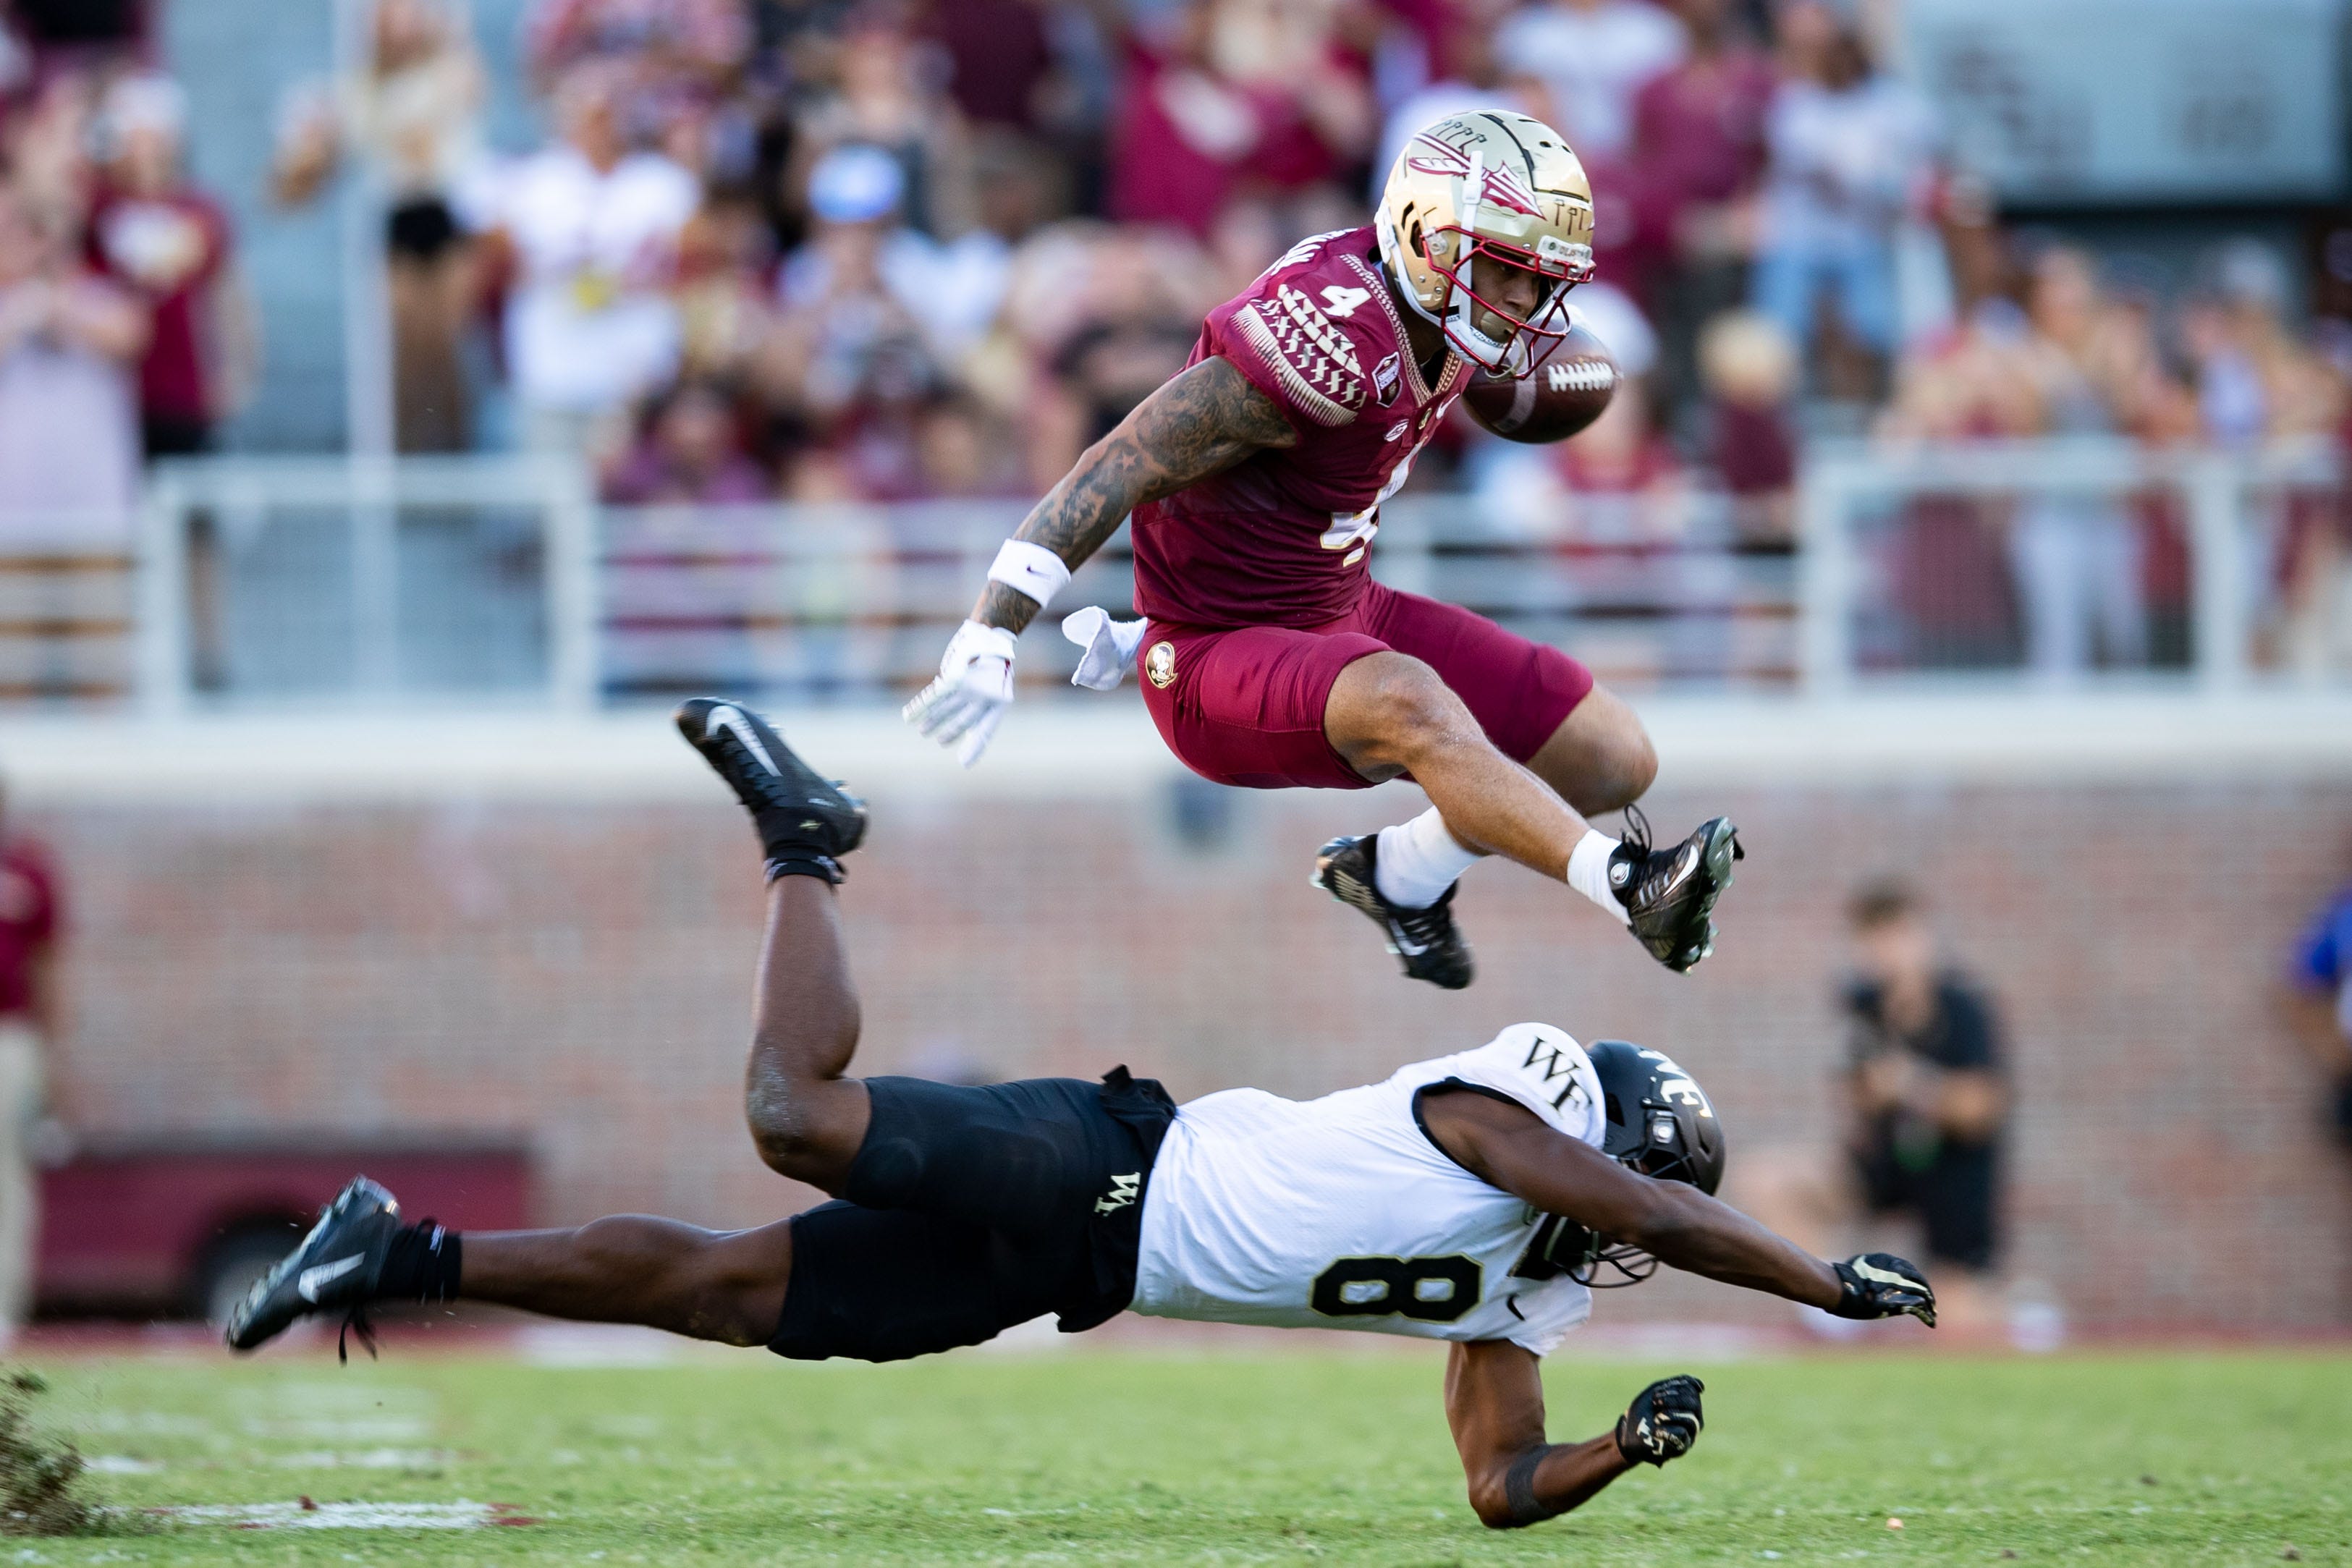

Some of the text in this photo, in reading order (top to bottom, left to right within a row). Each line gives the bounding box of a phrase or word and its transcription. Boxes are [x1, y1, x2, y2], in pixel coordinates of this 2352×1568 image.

[1319, 285, 1372, 318] 4
[1522, 1035, 1594, 1119] WF
[1308, 1252, 1485, 1324] 8
